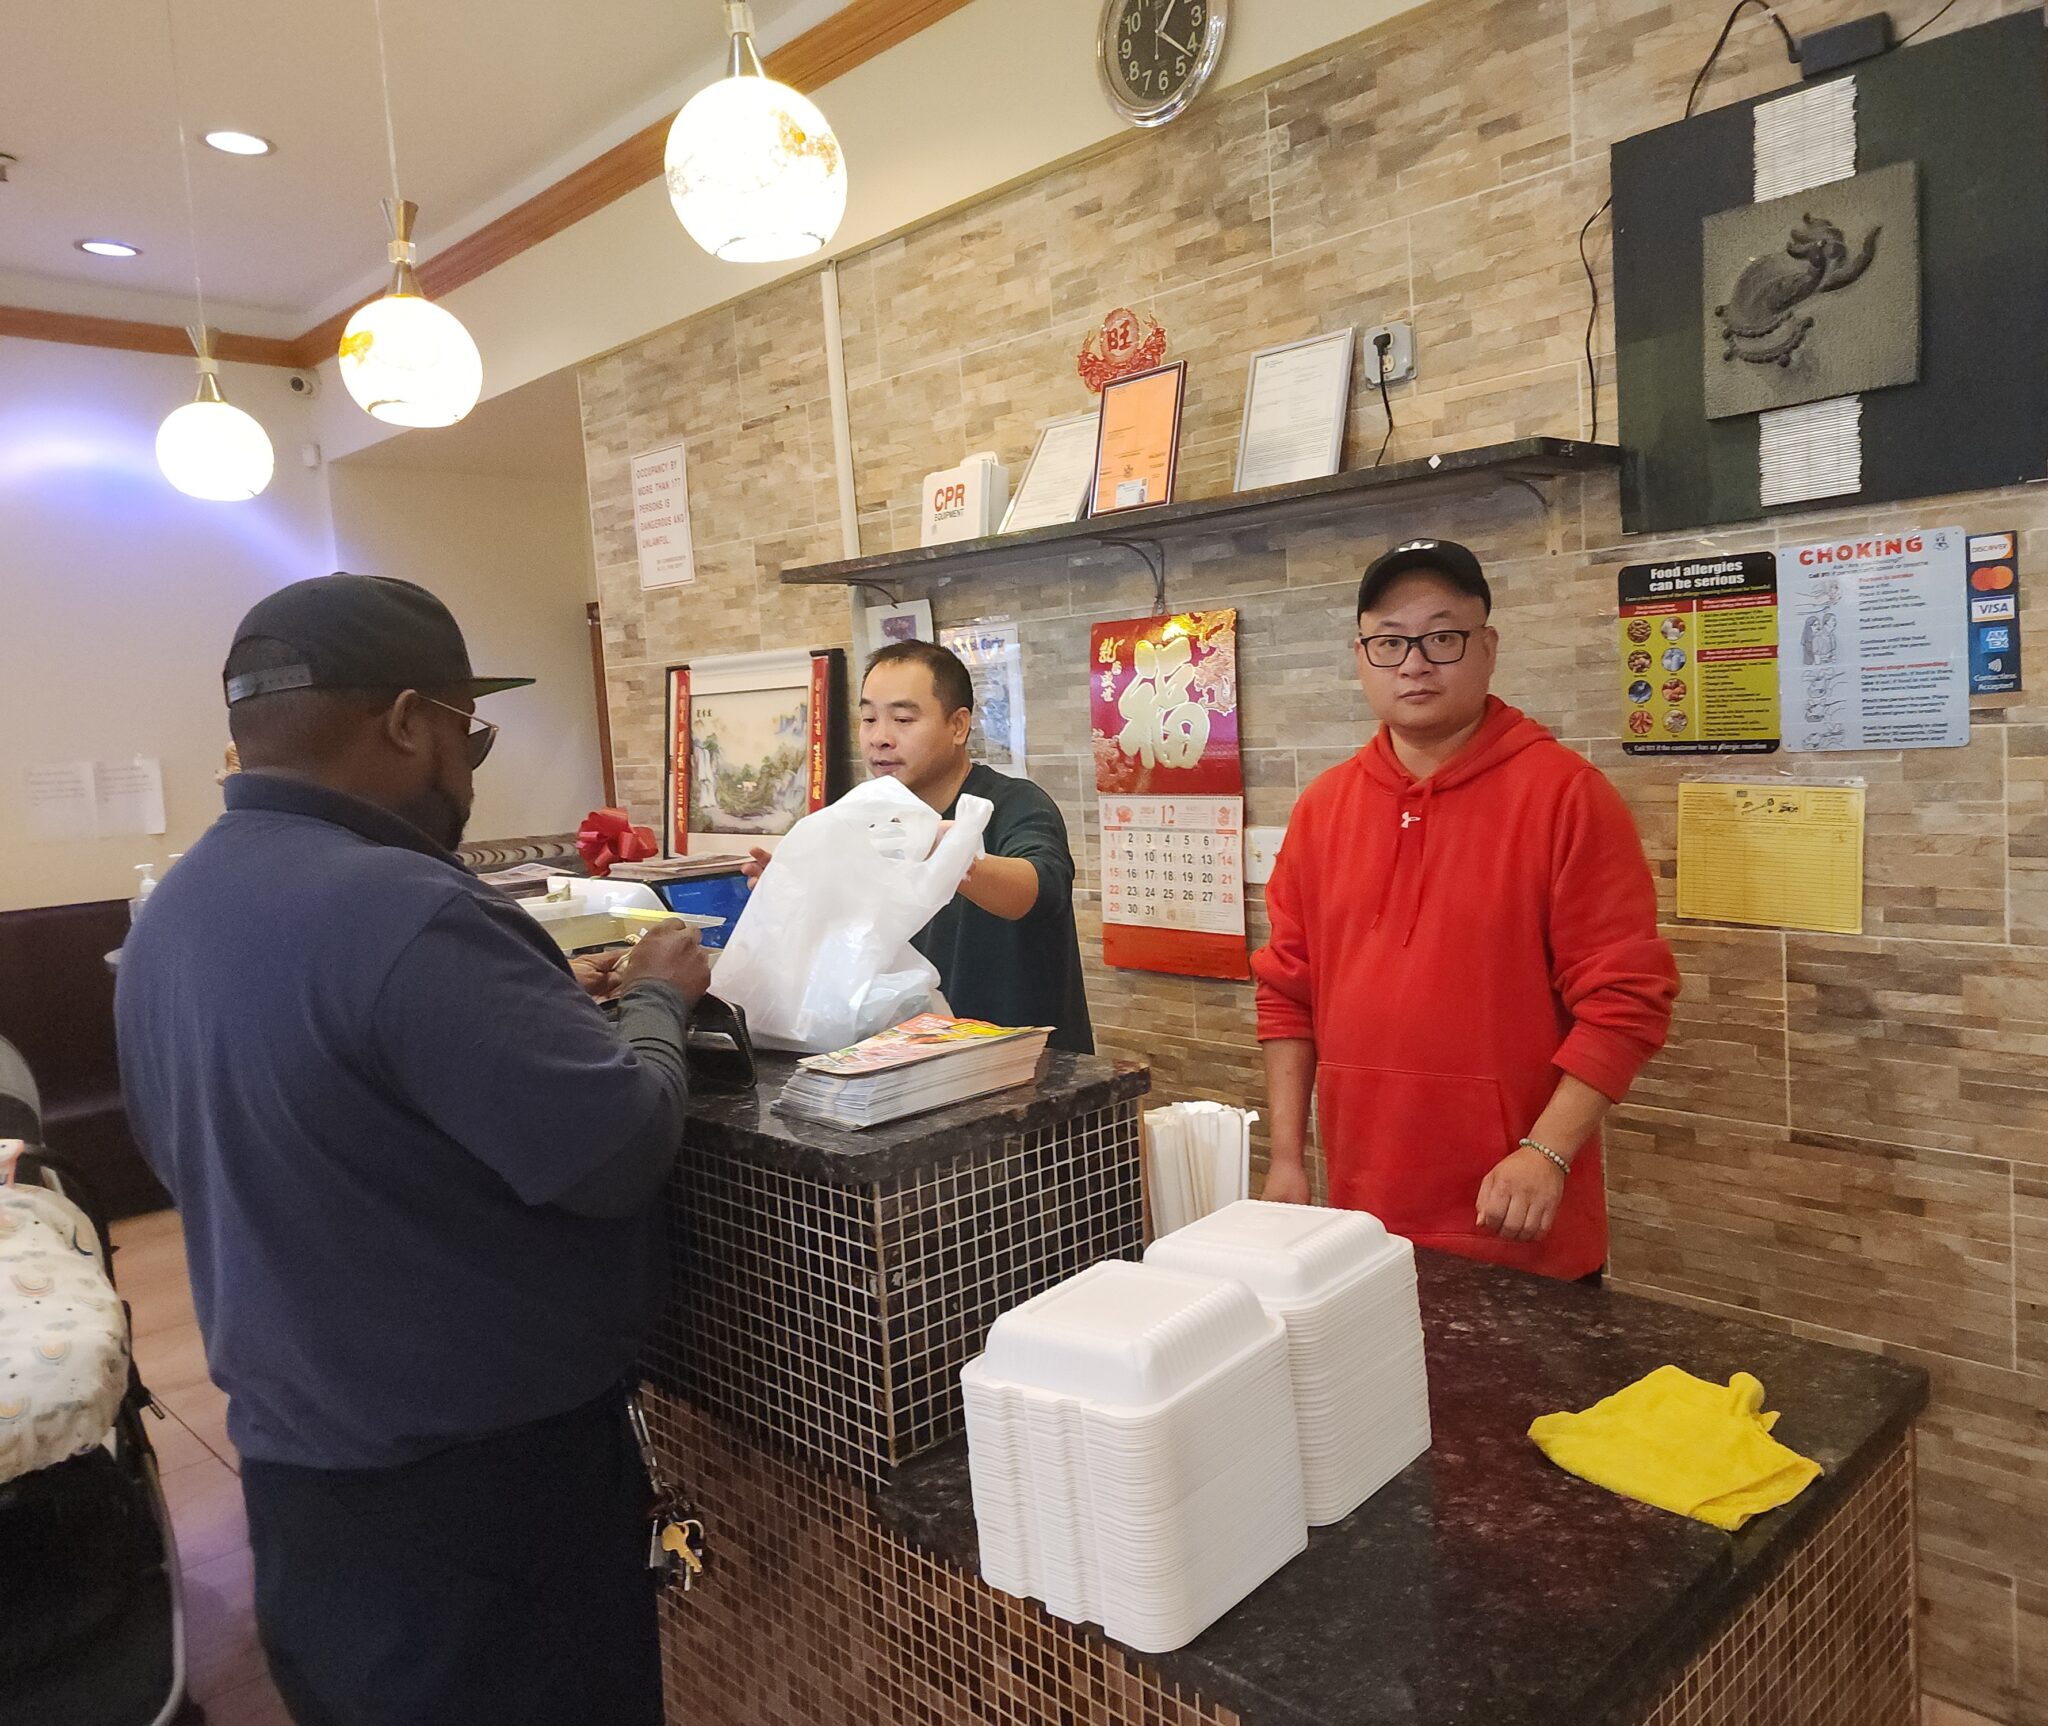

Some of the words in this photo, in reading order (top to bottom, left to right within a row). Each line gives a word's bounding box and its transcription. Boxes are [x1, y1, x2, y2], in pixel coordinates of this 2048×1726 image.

[1125, 12, 1141, 35] 10
[1191, 6, 1203, 26] 3
[1121, 39, 1131, 59] 9
[1187, 32, 1198, 51] 4
[1129, 61, 1139, 80] 8
[1175, 55, 1186, 76] 5
[1142, 70, 1152, 91] 7
[1158, 70, 1168, 90] 6
[1107, 319, 1132, 351] 旺
[636, 463, 668, 479] OCCUPANCY
[638, 485, 653, 496] MORE
[655, 482, 669, 490] THAN
[934, 483, 965, 512] CPR
[639, 500, 663, 513] PERSONS
[665, 498, 670, 508] IS
[640, 516, 672, 531] DANGEROUS
[674, 514, 684, 523] AND
[934, 508, 964, 522] EQUIPMENT
[1799, 536, 1924, 566] CHOKING
[1972, 543, 2007, 553] DISCOVER
[1651, 566, 1680, 579] Food
[1683, 561, 1743, 576] allergies
[1649, 580, 1673, 592] can
[1676, 579, 1692, 590] be
[1694, 574, 1744, 587] serious
[1979, 602, 2008, 615] VISA
[1161, 805, 1175, 824] 12
[1128, 833, 1134, 843] 2
[1146, 834, 1152, 844] 3
[1165, 834, 1171, 844] 4
[1184, 835, 1190, 845] 5
[1203, 836, 1209, 846] 6
[1223, 837, 1230, 847] 7
[1110, 850, 1116, 859] 8
[1128, 851, 1133, 861] 9
[1145, 852, 1154, 862] 10
[1163, 853, 1173, 862] 11
[1182, 853, 1193, 864] 12
[1201, 854, 1212, 865] 13
[1221, 855, 1232, 865] 14
[1109, 868, 1119, 876] 15
[1127, 869, 1137, 878] 16
[1145, 870, 1155, 880] 17
[1163, 871, 1174, 880] 18
[1182, 872, 1193, 881] 19
[1202, 873, 1213, 883] 20
[1221, 874, 1232, 884] 21
[1109, 885, 1119, 894] 22
[1127, 886, 1137, 896] 23
[1145, 888, 1155, 897] 24
[1163, 889, 1174, 898] 25
[1182, 890, 1194, 900] 26
[1202, 892, 1213, 902] 27
[1222, 893, 1233, 903] 28
[1109, 902, 1119, 912] 29
[1128, 904, 1137, 913] 30
[1145, 906, 1155, 915] 31
